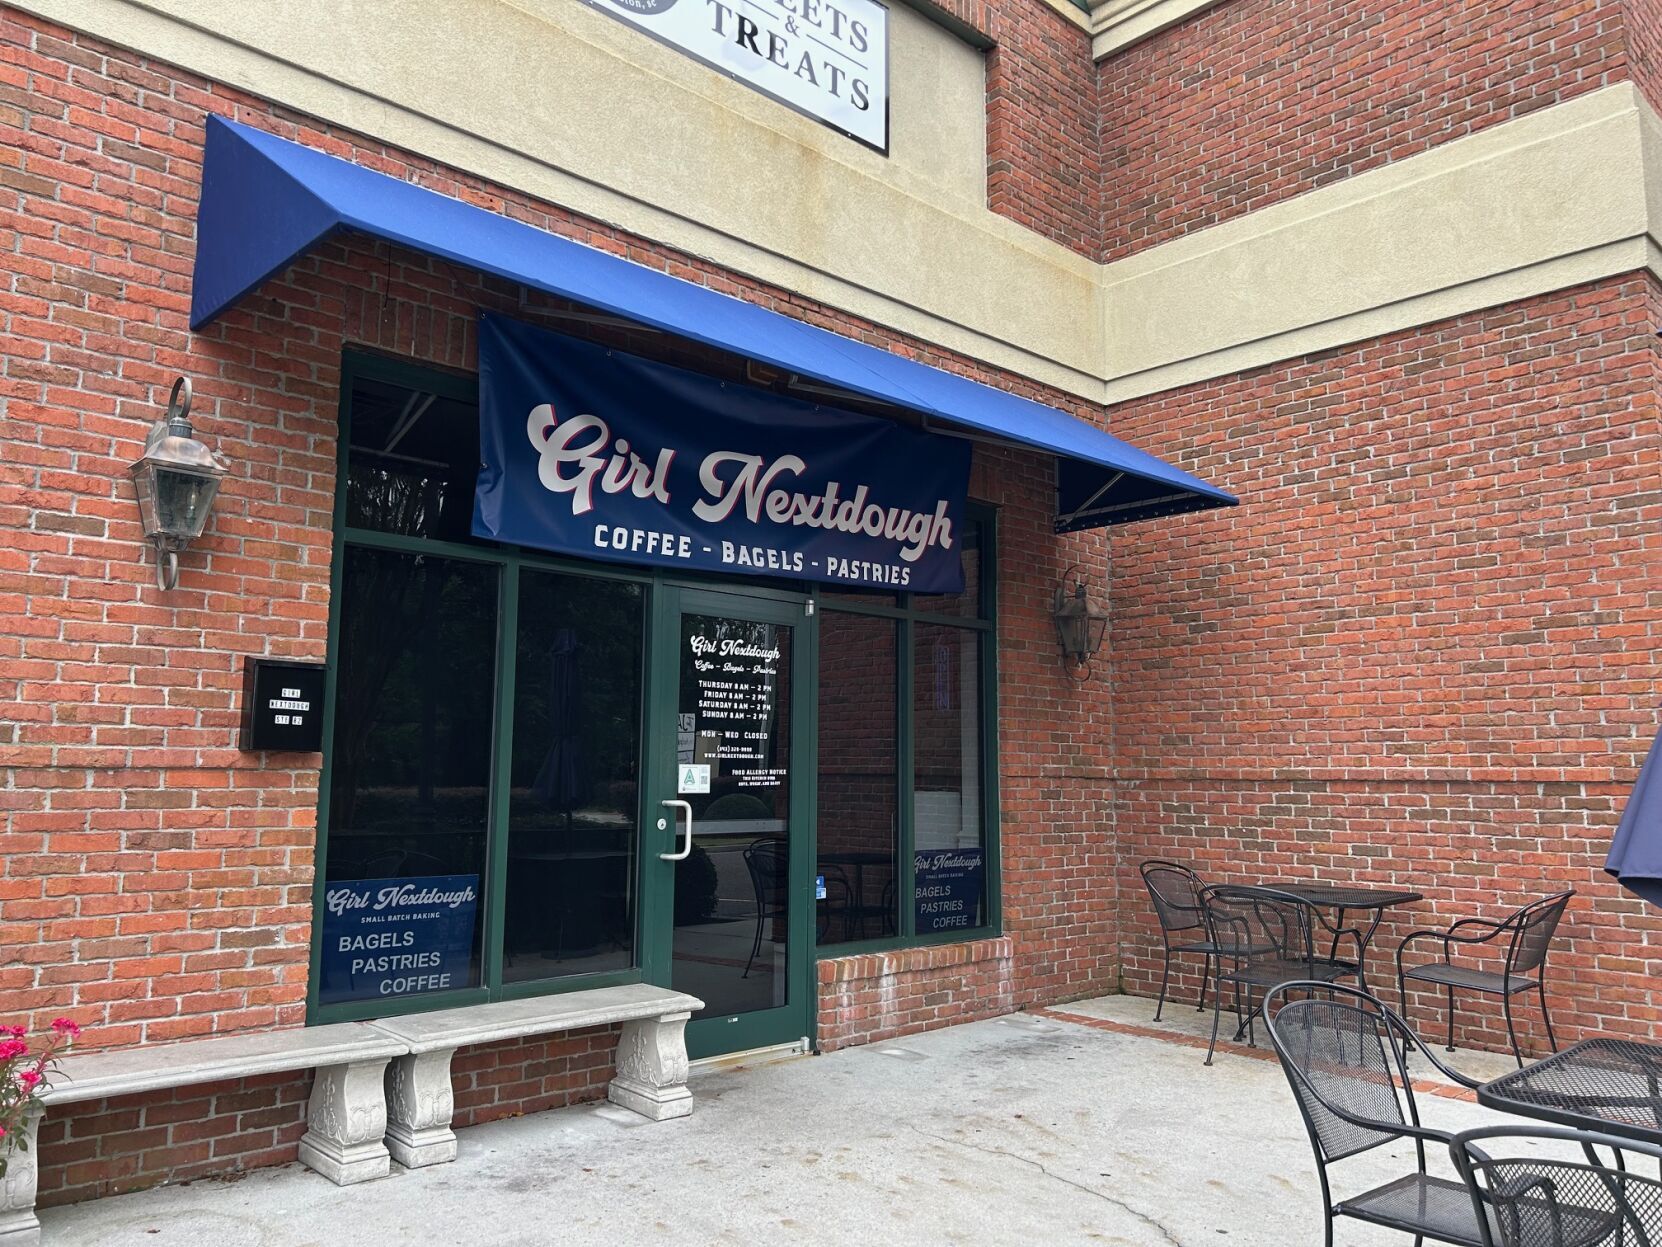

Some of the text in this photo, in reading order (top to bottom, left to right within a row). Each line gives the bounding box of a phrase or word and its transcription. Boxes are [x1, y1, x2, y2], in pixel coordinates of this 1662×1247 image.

[785, 15, 800, 38] &
[706, 1, 870, 111] TREATS
[527, 403, 953, 562] Girl Nextdough
[594, 524, 692, 559] COFFEE
[721, 540, 804, 572] BAGELS
[826, 556, 911, 585] PASTRIES
[690, 635, 780, 662] Girl Nextdough
[695, 660, 714, 671] Coffee
[723, 662, 744, 673] Bagels
[699, 680, 733, 689] THURSDAY
[704, 690, 727, 698] FRIDAY
[699, 700, 732, 708] SATURDAY
[702, 710, 728, 718] SUNDAY
[701, 730, 716, 738] MON
[744, 731, 768, 739] CLOSED
[932, 853, 981, 870] Nextdough
[915, 885, 951, 898] BAGELS
[326, 884, 475, 916] Girl Nextdough
[920, 900, 963, 914] PASTRIES
[361, 912, 441, 924] SMALL BATCH BAKING
[933, 915, 968, 928] COFFEE
[338, 931, 414, 952] BAGELS
[351, 952, 441, 975] PASTRIES
[379, 973, 451, 995] COFFEE
